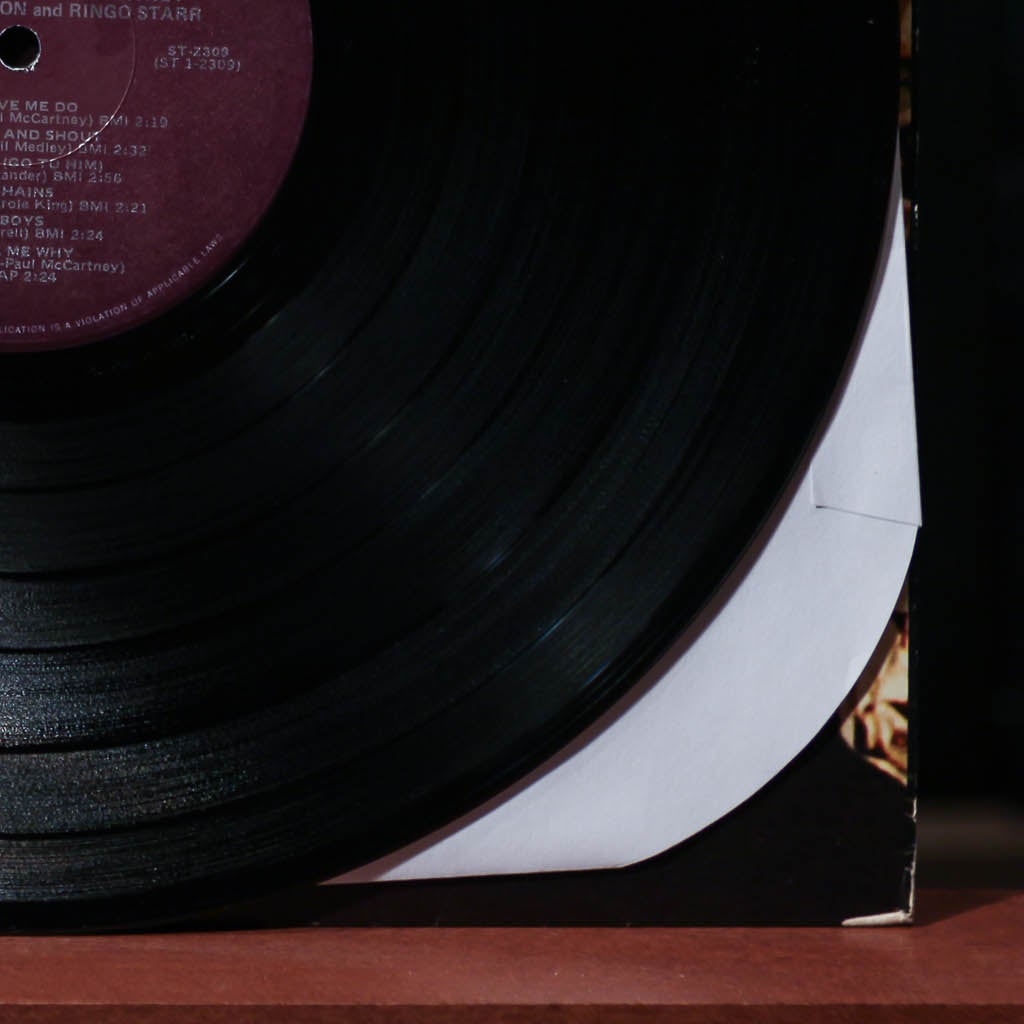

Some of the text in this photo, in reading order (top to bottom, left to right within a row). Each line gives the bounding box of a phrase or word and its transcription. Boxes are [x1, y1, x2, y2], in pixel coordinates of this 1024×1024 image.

[33, 4, 63, 18] and
[69, 3, 131, 20] RINGO
[137, 6, 202, 22] STARR
[167, 45, 230, 57] ST-2309
[25, 100, 49, 112] ME
[55, 101, 78, 113] DO
[9, 113, 94, 127] McCartney)
[99, 115, 129, 126] BMI
[135, 116, 168, 128] 2:19
[3, 128, 40, 141] AND
[45, 130, 99, 142] SHOUT
[15, 140, 73, 155] Medley)
[113, 145, 147, 157] 2:32
[2, 157, 33, 168] (GO
[38, 158, 60, 169] TO
[65, 159, 103, 173] HIM)
[53, 171, 82, 182] BMI
[88, 172, 122, 184] 2:56
[34, 198, 73, 213] King)
[79, 200, 108, 212] BMI
[115, 202, 147, 214] 2:21
[0, 215, 44, 226] BOYS
[35, 228, 64, 239] BMI
[71, 229, 104, 241] 2:24
[7, 245, 31, 257] ME
[36, 247, 74, 258] WHY
[41, 259, 125, 274] McCartney)
[24, 271, 57, 283] 2:24
[50, 322, 61, 332] IS
[65, 321, 72, 329] A
[75, 303, 128, 328] VIOLATION
[130, 295, 144, 307] OF
